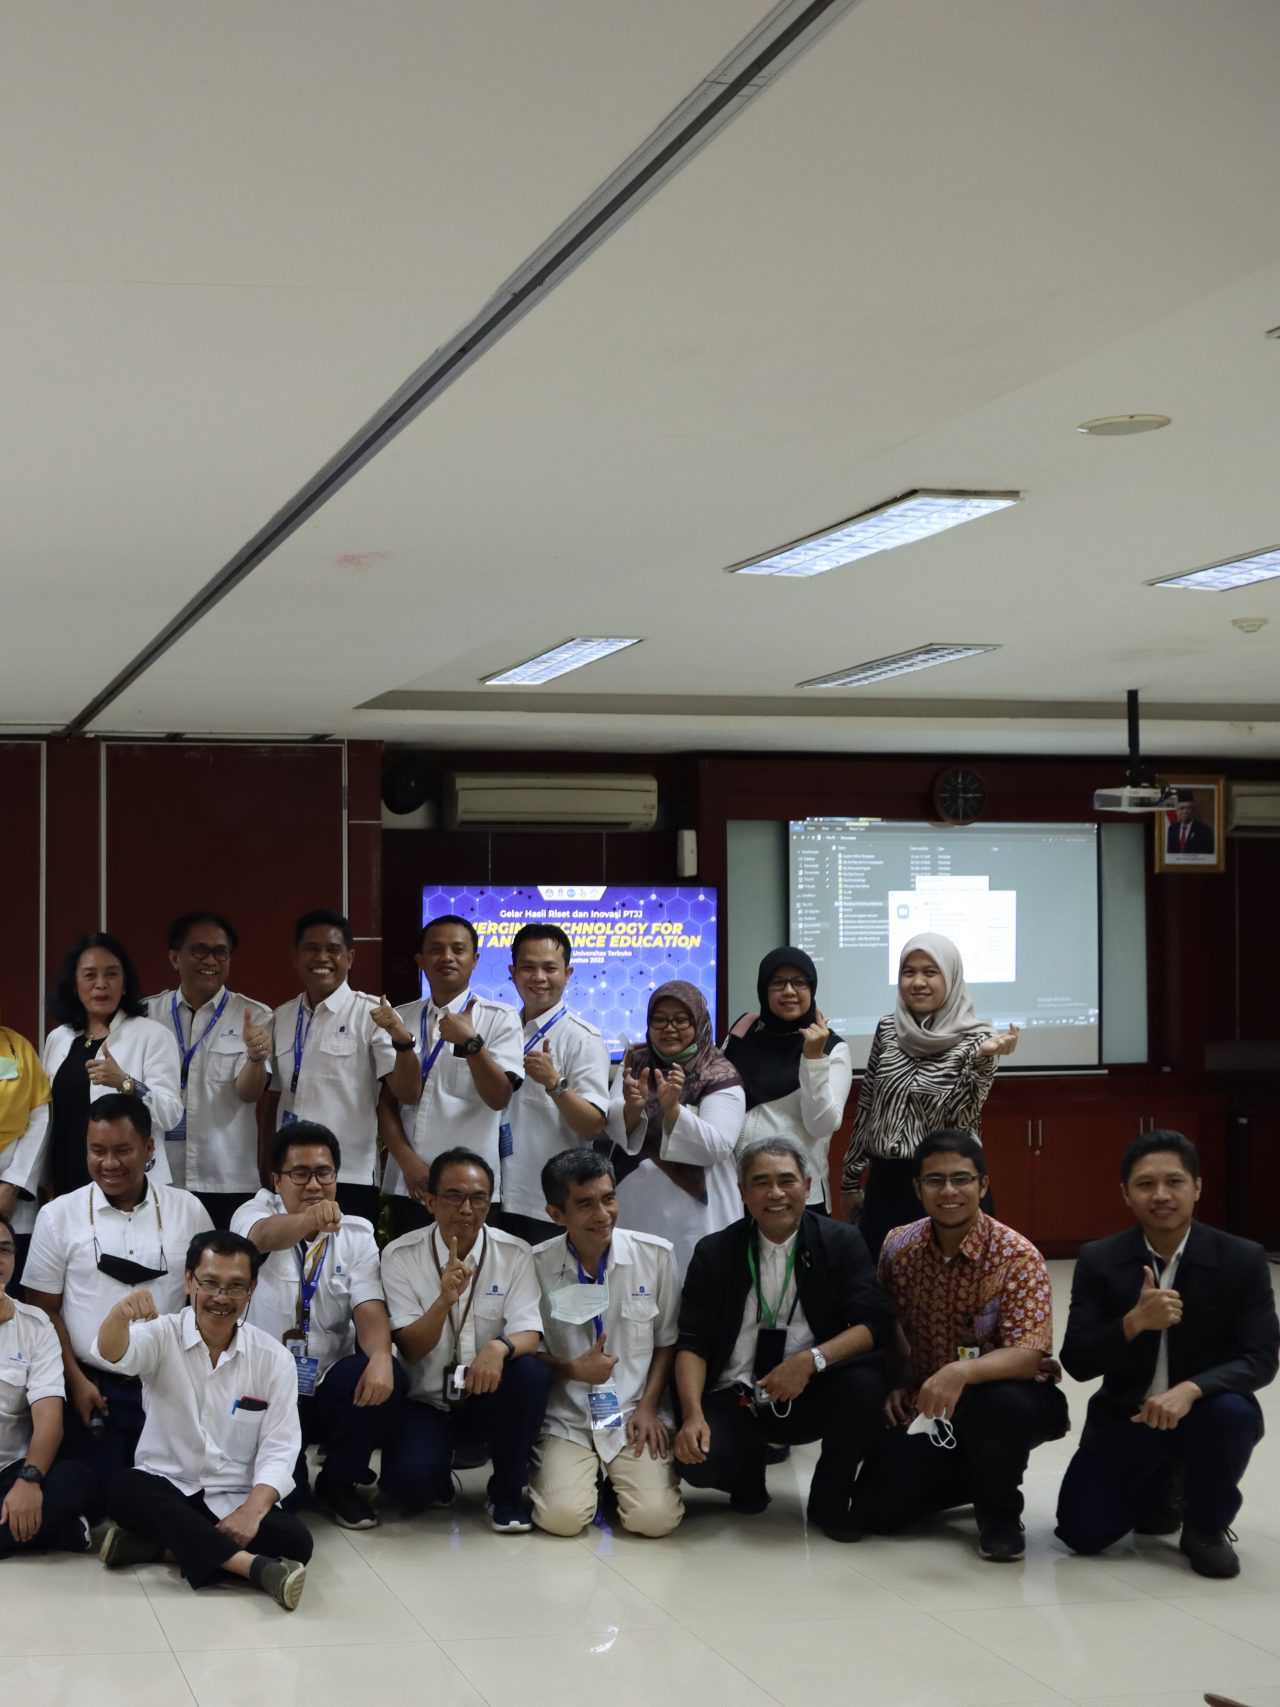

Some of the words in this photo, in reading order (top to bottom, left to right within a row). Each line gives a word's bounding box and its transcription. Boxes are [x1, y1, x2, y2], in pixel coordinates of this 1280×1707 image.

[500, 909, 523, 918] Gelar
[525, 909, 546, 918] Hasil
[548, 910, 571, 918] Riset
[572, 910, 589, 918] dan
[590, 910, 621, 918] Inovasi
[623, 910, 643, 919] PTJJ
[542, 922, 649, 935] CHNOLOGY
[651, 922, 684, 935] FOR
[610, 935, 701, 947] EDUCATION
